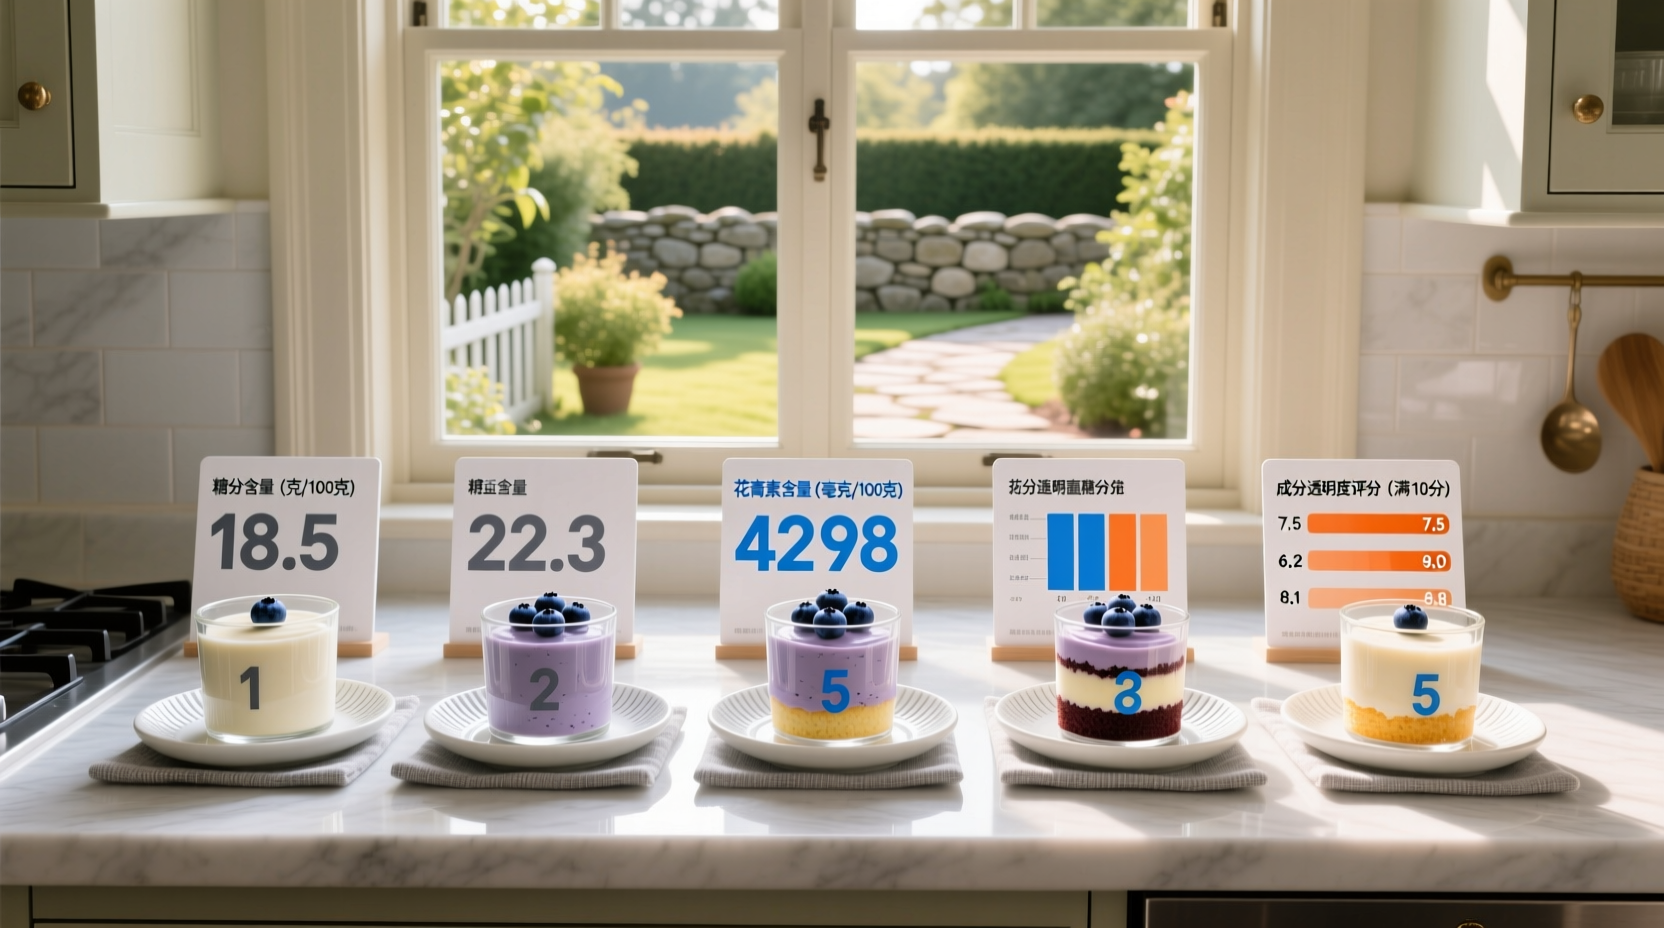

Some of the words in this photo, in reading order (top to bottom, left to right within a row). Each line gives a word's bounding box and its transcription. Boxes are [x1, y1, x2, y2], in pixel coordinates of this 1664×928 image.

[280, 477, 355, 498] (克/100克)
[1276, 479, 1381, 497] 成分透明度评分
[210, 513, 339, 571] 18.5
[467, 513, 606, 573] 22.3
[734, 514, 898, 573] 4298
[1278, 516, 1302, 531] 7.5
[1422, 517, 1445, 532] 7.5
[1278, 554, 1303, 569] 6.2
[1280, 590, 1300, 605] 8.1
[240, 666, 260, 710] 1
[530, 668, 559, 711] 2
[821, 669, 850, 714] 5
[1412, 673, 1440, 716] 5
